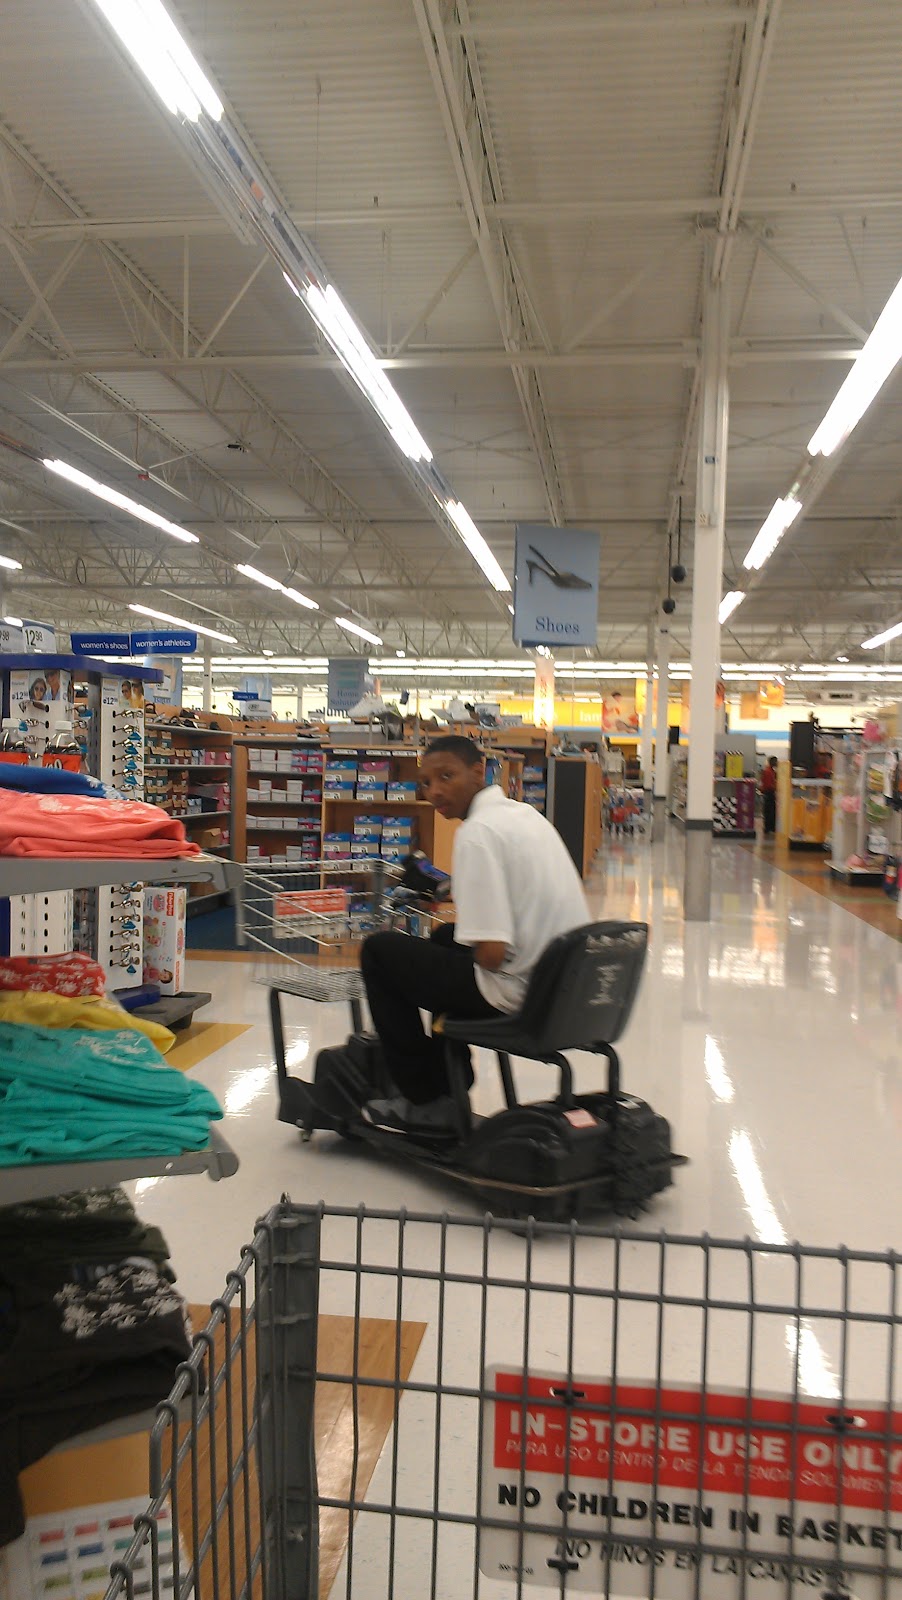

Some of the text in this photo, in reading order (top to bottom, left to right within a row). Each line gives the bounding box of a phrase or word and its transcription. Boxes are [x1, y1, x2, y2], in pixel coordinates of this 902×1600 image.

[535, 616, 580, 634] Shoes
[80, 642, 129, 650] women's shoes
[135, 639, 191, 648] women's athletics
[509, 1410, 902, 1475] IN-STORE USE ONLY
[505, 1439, 548, 1457] PARA
[555, 1444, 591, 1461] USO
[672, 1456, 698, 1473] DE
[702, 1460, 725, 1475] LA
[733, 1463, 794, 1483] TENDA
[498, 1483, 541, 1508] NO
[556, 1489, 714, 1529] CHILDREN
[728, 1508, 761, 1536] IN
